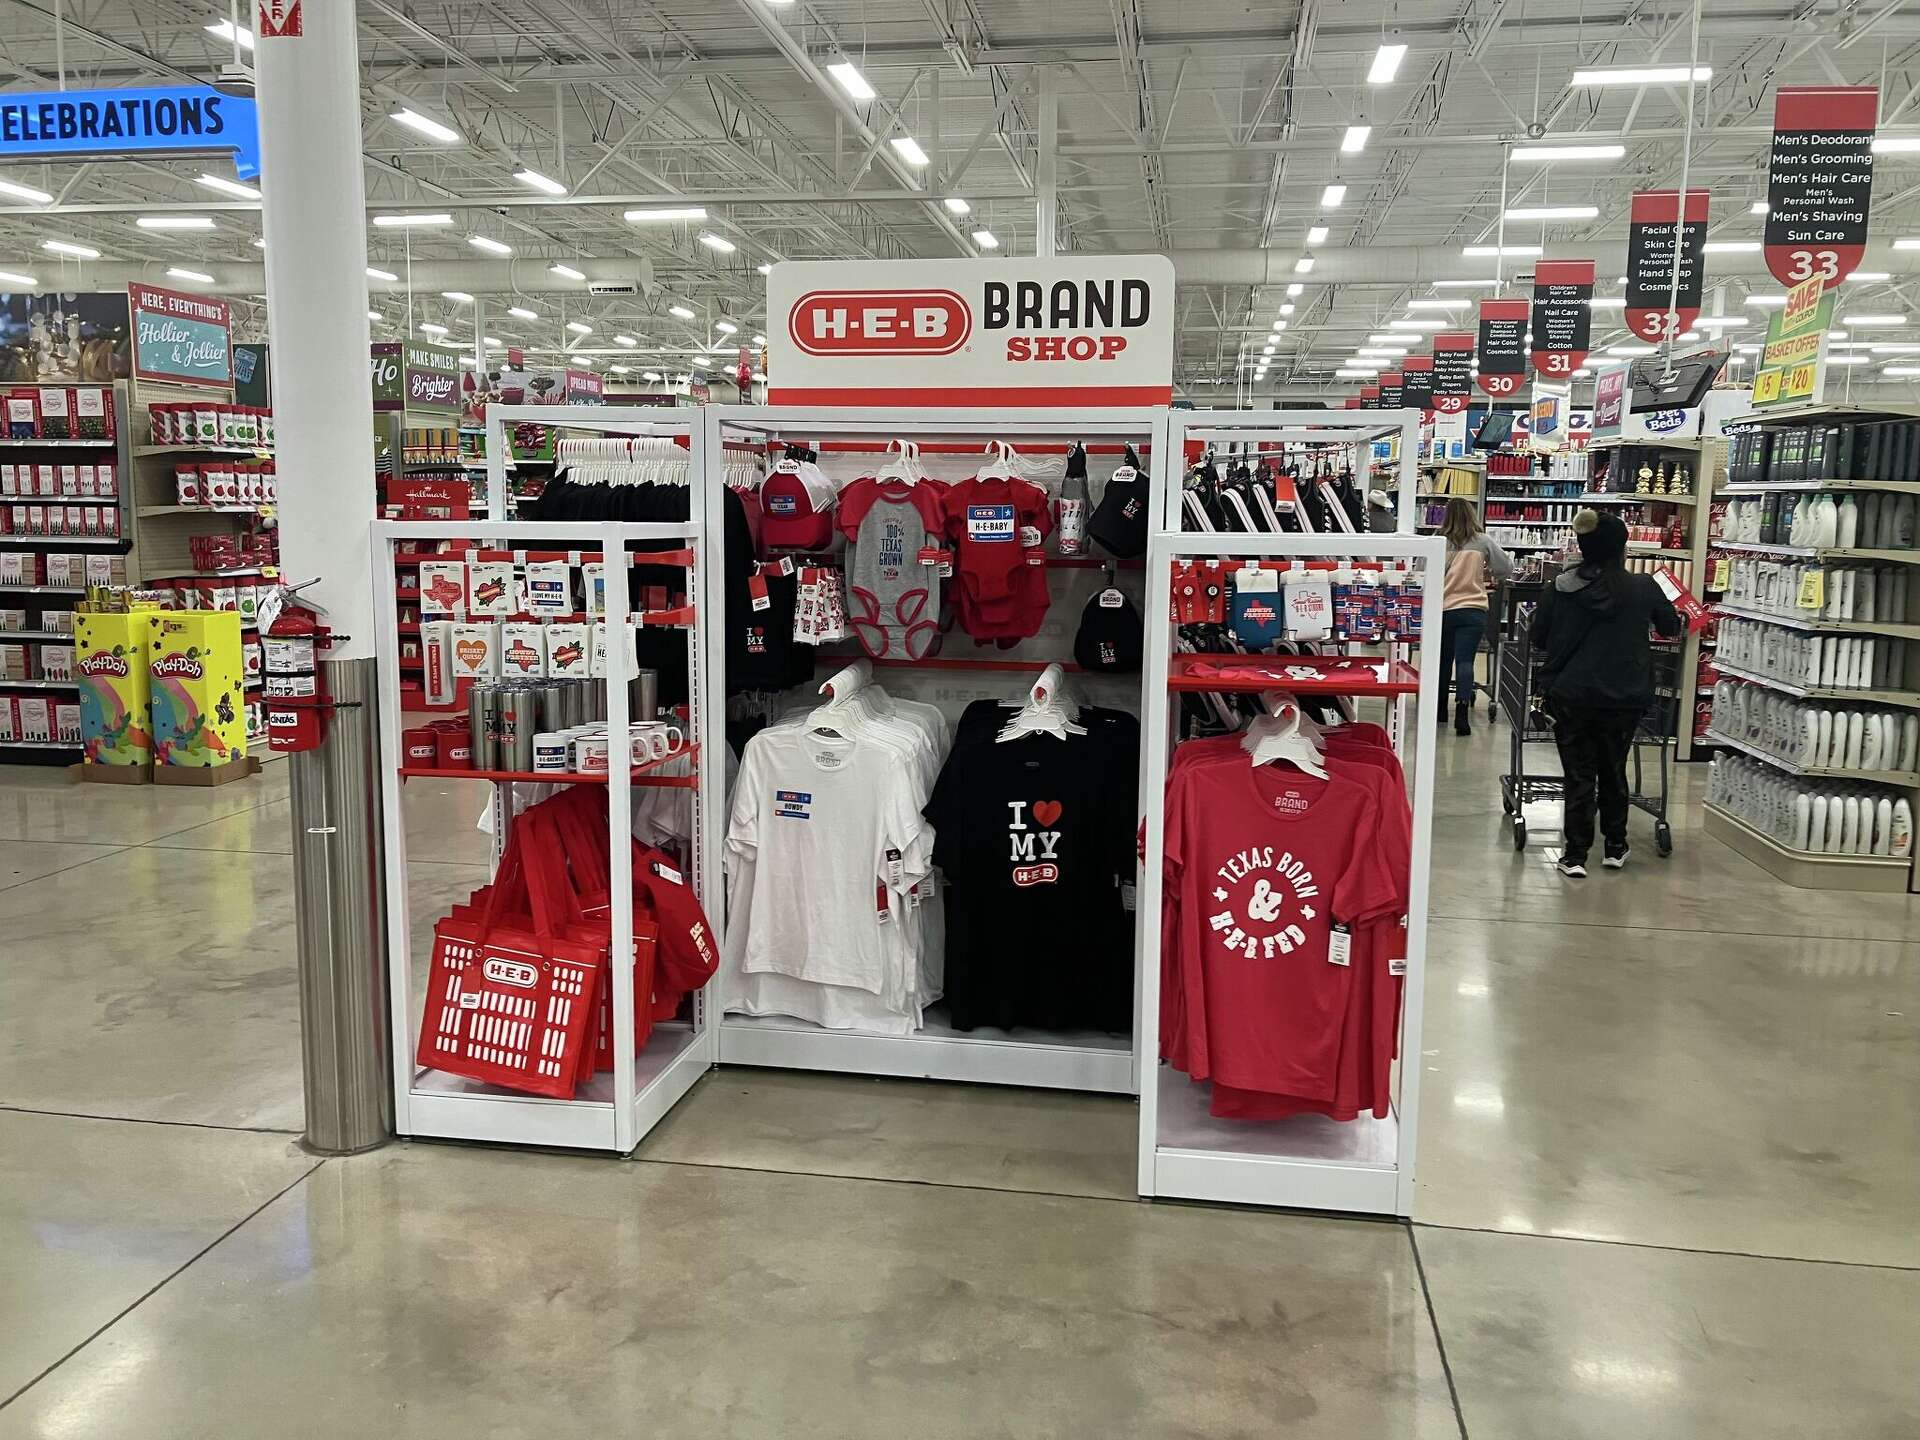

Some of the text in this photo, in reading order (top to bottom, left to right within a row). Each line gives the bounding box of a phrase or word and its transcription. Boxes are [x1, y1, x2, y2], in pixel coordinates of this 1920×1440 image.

[0, 97, 224, 141] ELEBRATIONS
[1775, 134, 1874, 145] Men's Deodorant
[1773, 153, 1873, 165] Men's Grooming
[1772, 173, 1871, 183] Men's Hair Care
[1784, 197, 1854, 205] Personal Wash
[1773, 211, 1863, 223] Men's Shaving
[1642, 226, 1670, 234] Facial
[1788, 231, 1845, 240] Sun Care
[1645, 241, 1665, 249] Skin
[1788, 251, 1839, 281] 33
[1667, 270, 1692, 278] Sap
[1640, 283, 1690, 291] Cosmecs
[984, 279, 1151, 330] BRAND
[1785, 279, 1821, 318] SAVE!
[141, 292, 222, 320] HERE, EVERYTHING'S
[812, 307, 948, 339] H-E-B
[1643, 312, 1680, 335] 32
[139, 321, 190, 345] Hollier
[172, 341, 226, 368] & Jollier
[1007, 336, 1128, 362] SHOP
[1766, 337, 1795, 361] BASKET
[410, 349, 454, 370] MAKE SMILES
[1547, 354, 1570, 372] 31
[412, 375, 454, 401] Brighter
[1489, 377, 1513, 392] 30
[1762, 375, 1771, 395] $5
[1792, 368, 1809, 390] $20
[1441, 398, 1461, 410] 29
[1658, 409, 1680, 420] Pet
[1649, 417, 1682, 431] Beds
[1725, 425, 1751, 435] Beds
[406, 489, 451, 501] Hallmark
[887, 525, 904, 538] 100%
[976, 522, 1008, 531] H-E-BABY
[880, 539, 902, 552] TEXAS
[879, 552, 903, 566] GROWN
[747, 628, 752, 636] I
[747, 637, 763, 645] MY
[81, 656, 127, 674] Play-Doh
[154, 658, 201, 676] Play-Doh
[485, 710, 493, 720] I
[785, 803, 803, 811] HOWDY
[1275, 797, 1308, 810] BRAND
[1008, 801, 1027, 830] I
[1010, 832, 1061, 861] MY
[1018, 868, 1053, 881] H-E-B
[1217, 847, 1319, 899] TEXAS BORN
[1248, 879, 1283, 922] &
[490, 964, 531, 981] H-E-B
